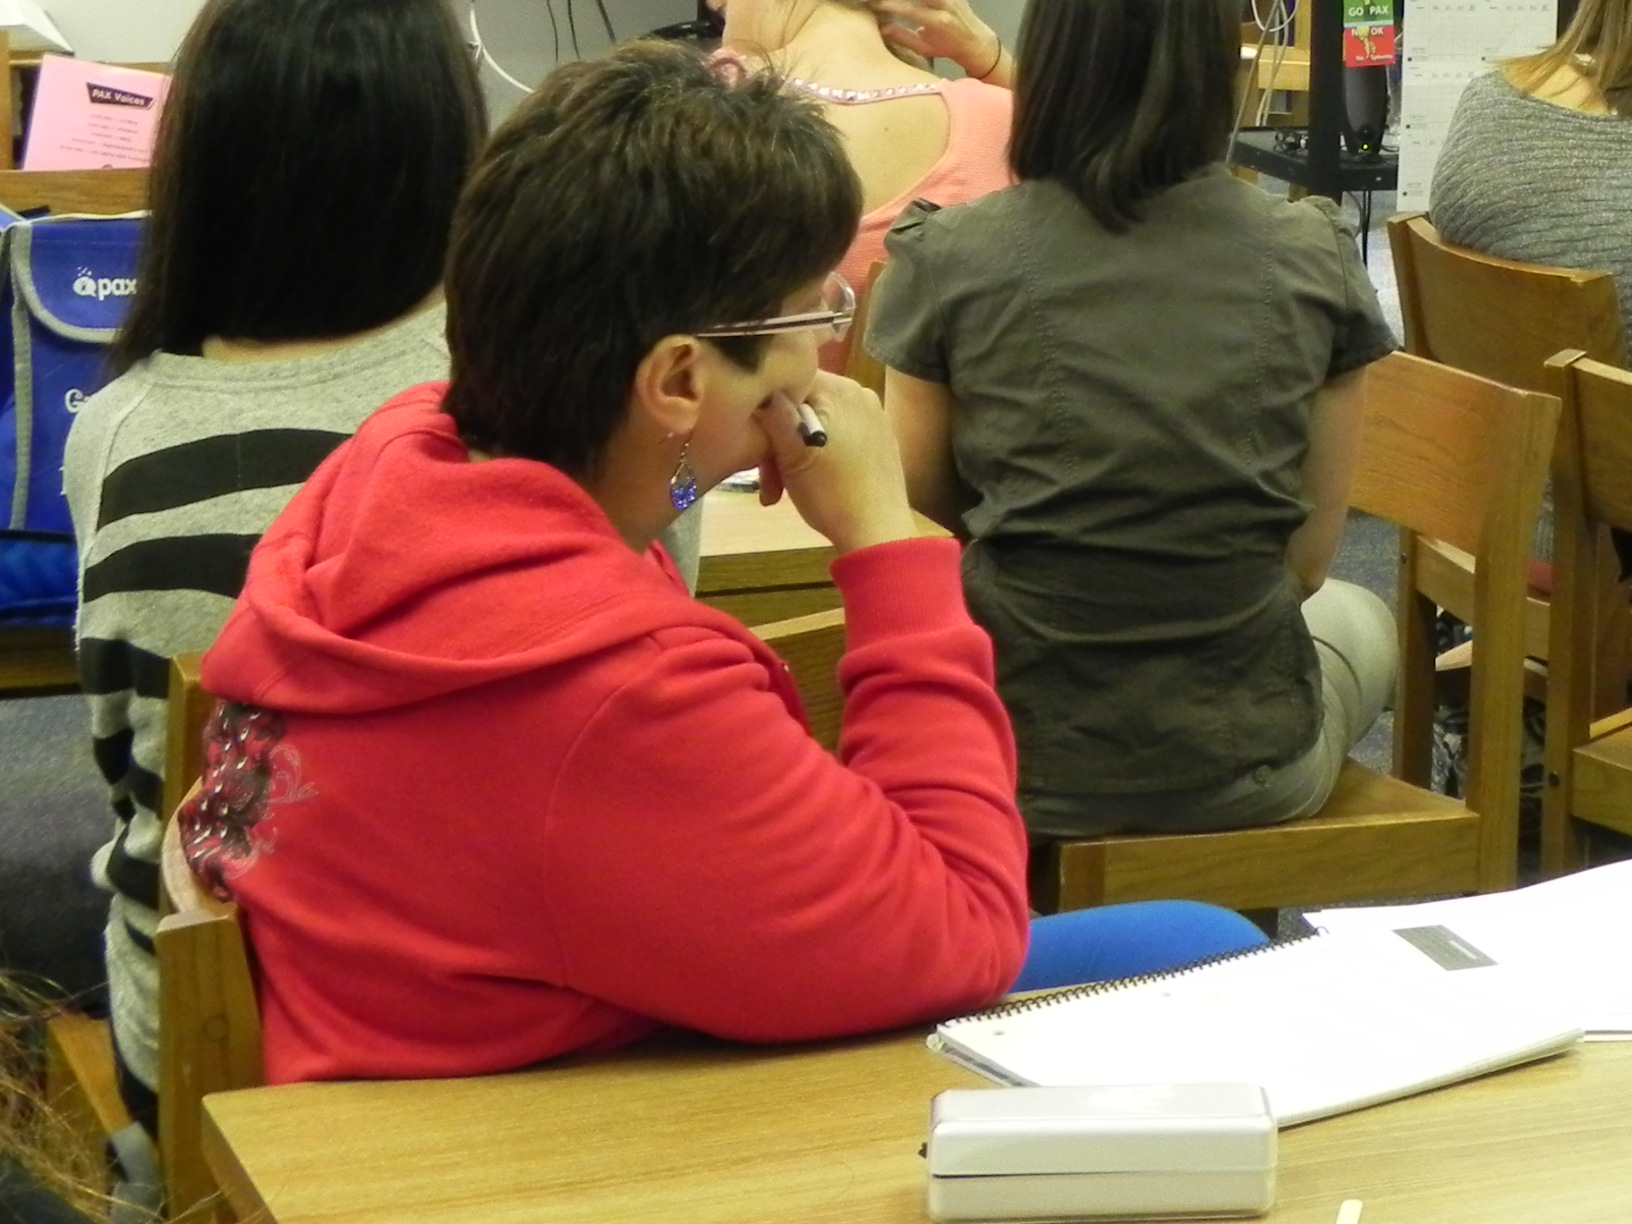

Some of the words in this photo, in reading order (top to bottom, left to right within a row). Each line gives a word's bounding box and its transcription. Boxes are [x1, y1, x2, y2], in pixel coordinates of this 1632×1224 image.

[1349, 6, 1364, 16] GO
[1369, 5, 1389, 15] PAX
[1371, 26, 1384, 36] OK
[92, 88, 111, 100] PAX
[114, 92, 146, 107] Voices
[98, 277, 137, 301] pax
